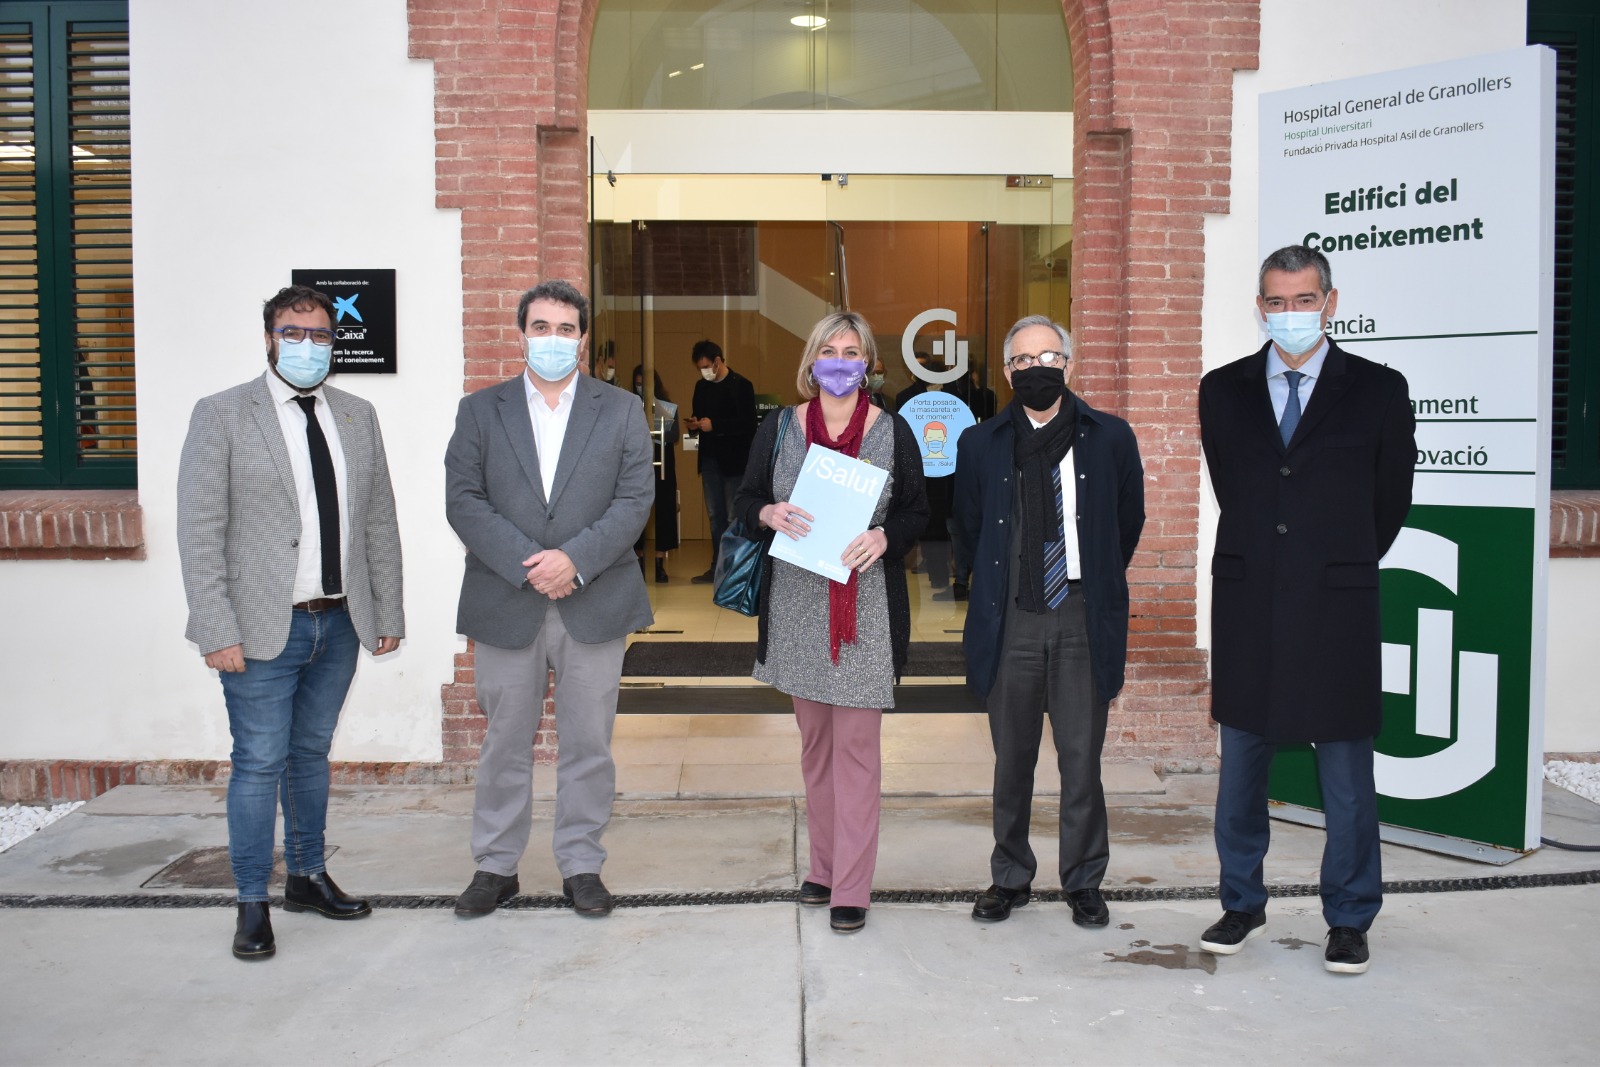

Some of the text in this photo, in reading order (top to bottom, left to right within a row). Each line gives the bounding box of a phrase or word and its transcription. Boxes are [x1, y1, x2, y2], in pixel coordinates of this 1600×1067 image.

[1284, 75, 1512, 124] Hospital General de Granollers
[1283, 120, 1484, 157] Fundació Privada Hospital Asil de Granollers
[1284, 119, 1372, 141] Hospital Universitari
[1324, 178, 1458, 215] Edifici del
[1302, 218, 1484, 254] Coneixement
[1324, 314, 1376, 335] encia
[1415, 445, 1488, 466] ovació
[806, 454, 879, 497] /Salut
